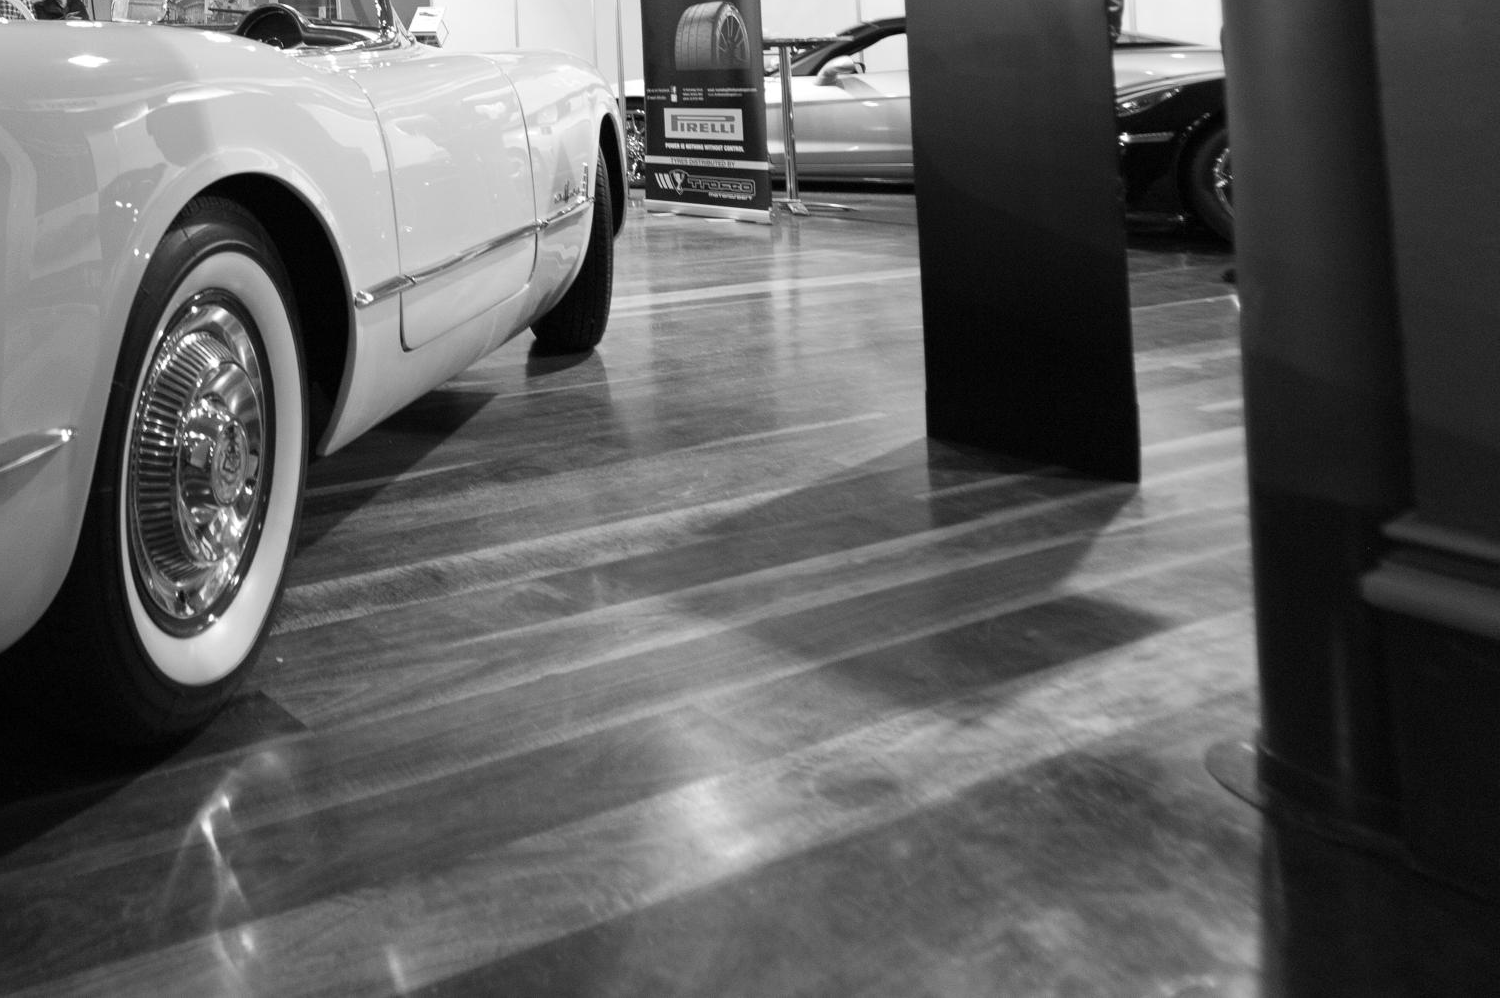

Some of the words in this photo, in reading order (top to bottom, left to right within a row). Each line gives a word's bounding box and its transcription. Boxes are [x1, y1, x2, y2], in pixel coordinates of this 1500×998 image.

[671, 114, 735, 134] PIRELLI
[704, 144, 723, 152] WITHOUT
[723, 145, 745, 153] CONTROL
